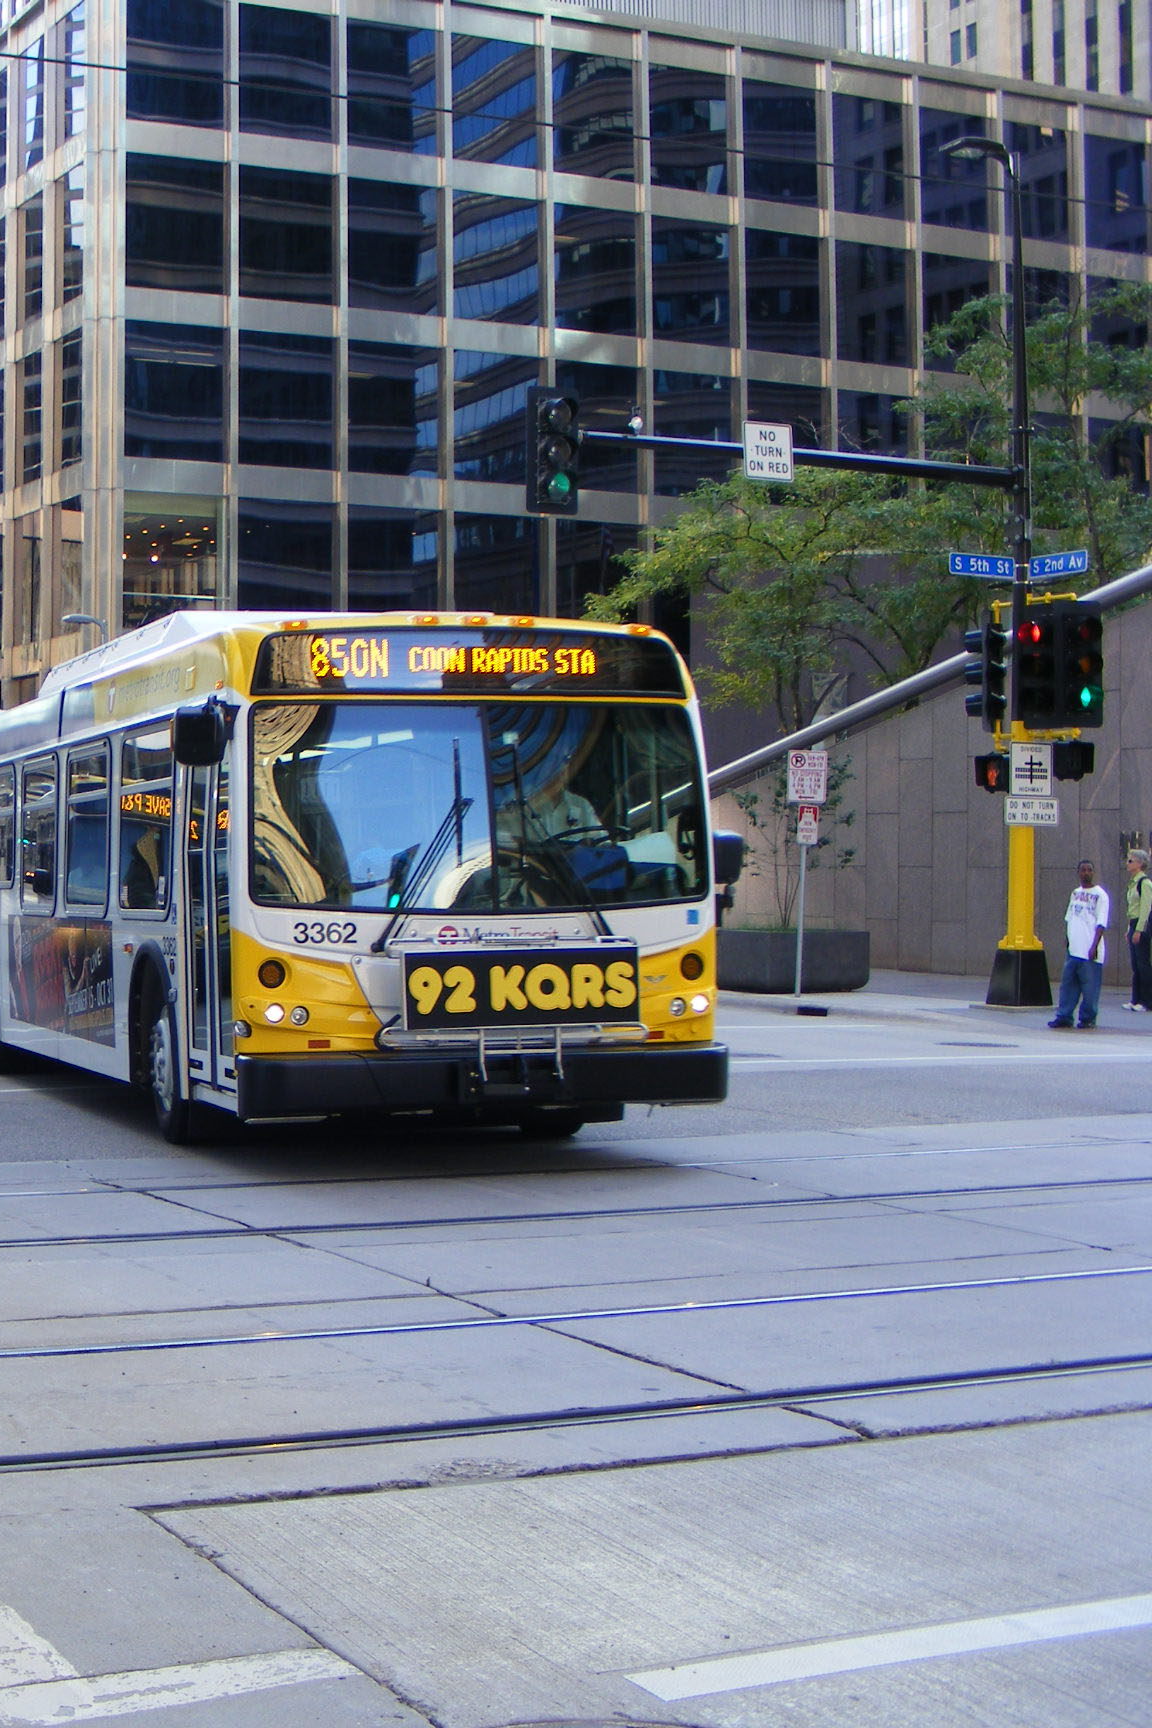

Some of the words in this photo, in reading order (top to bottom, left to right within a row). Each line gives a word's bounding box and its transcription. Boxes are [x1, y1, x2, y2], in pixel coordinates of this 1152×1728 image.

[759, 430, 776, 441] NO
[755, 445, 782, 458] TURN
[749, 460, 763, 471] ON
[768, 461, 789, 474] RED
[954, 556, 963, 570] S
[969, 557, 989, 572] 5th
[996, 560, 1009, 574] St
[1033, 560, 1040, 574] S
[1044, 557, 1064, 572] 2nd
[1068, 555, 1083, 569] Av
[311, 637, 389, 678] 850N
[408, 647, 466, 673] COON
[471, 647, 549, 674] RAPIDS
[554, 648, 596, 675] STA
[1010, 801, 1018, 809] DO
[1022, 801, 1034, 810] NOT
[1038, 801, 1054, 810] TURN
[1008, 813, 1016, 821] ON
[1020, 813, 1028, 821] TO
[1033, 813, 1055, 822] TRACKS
[293, 922, 357, 944] 3362
[409, 965, 477, 1014] 92
[489, 961, 637, 1011] KQRS
